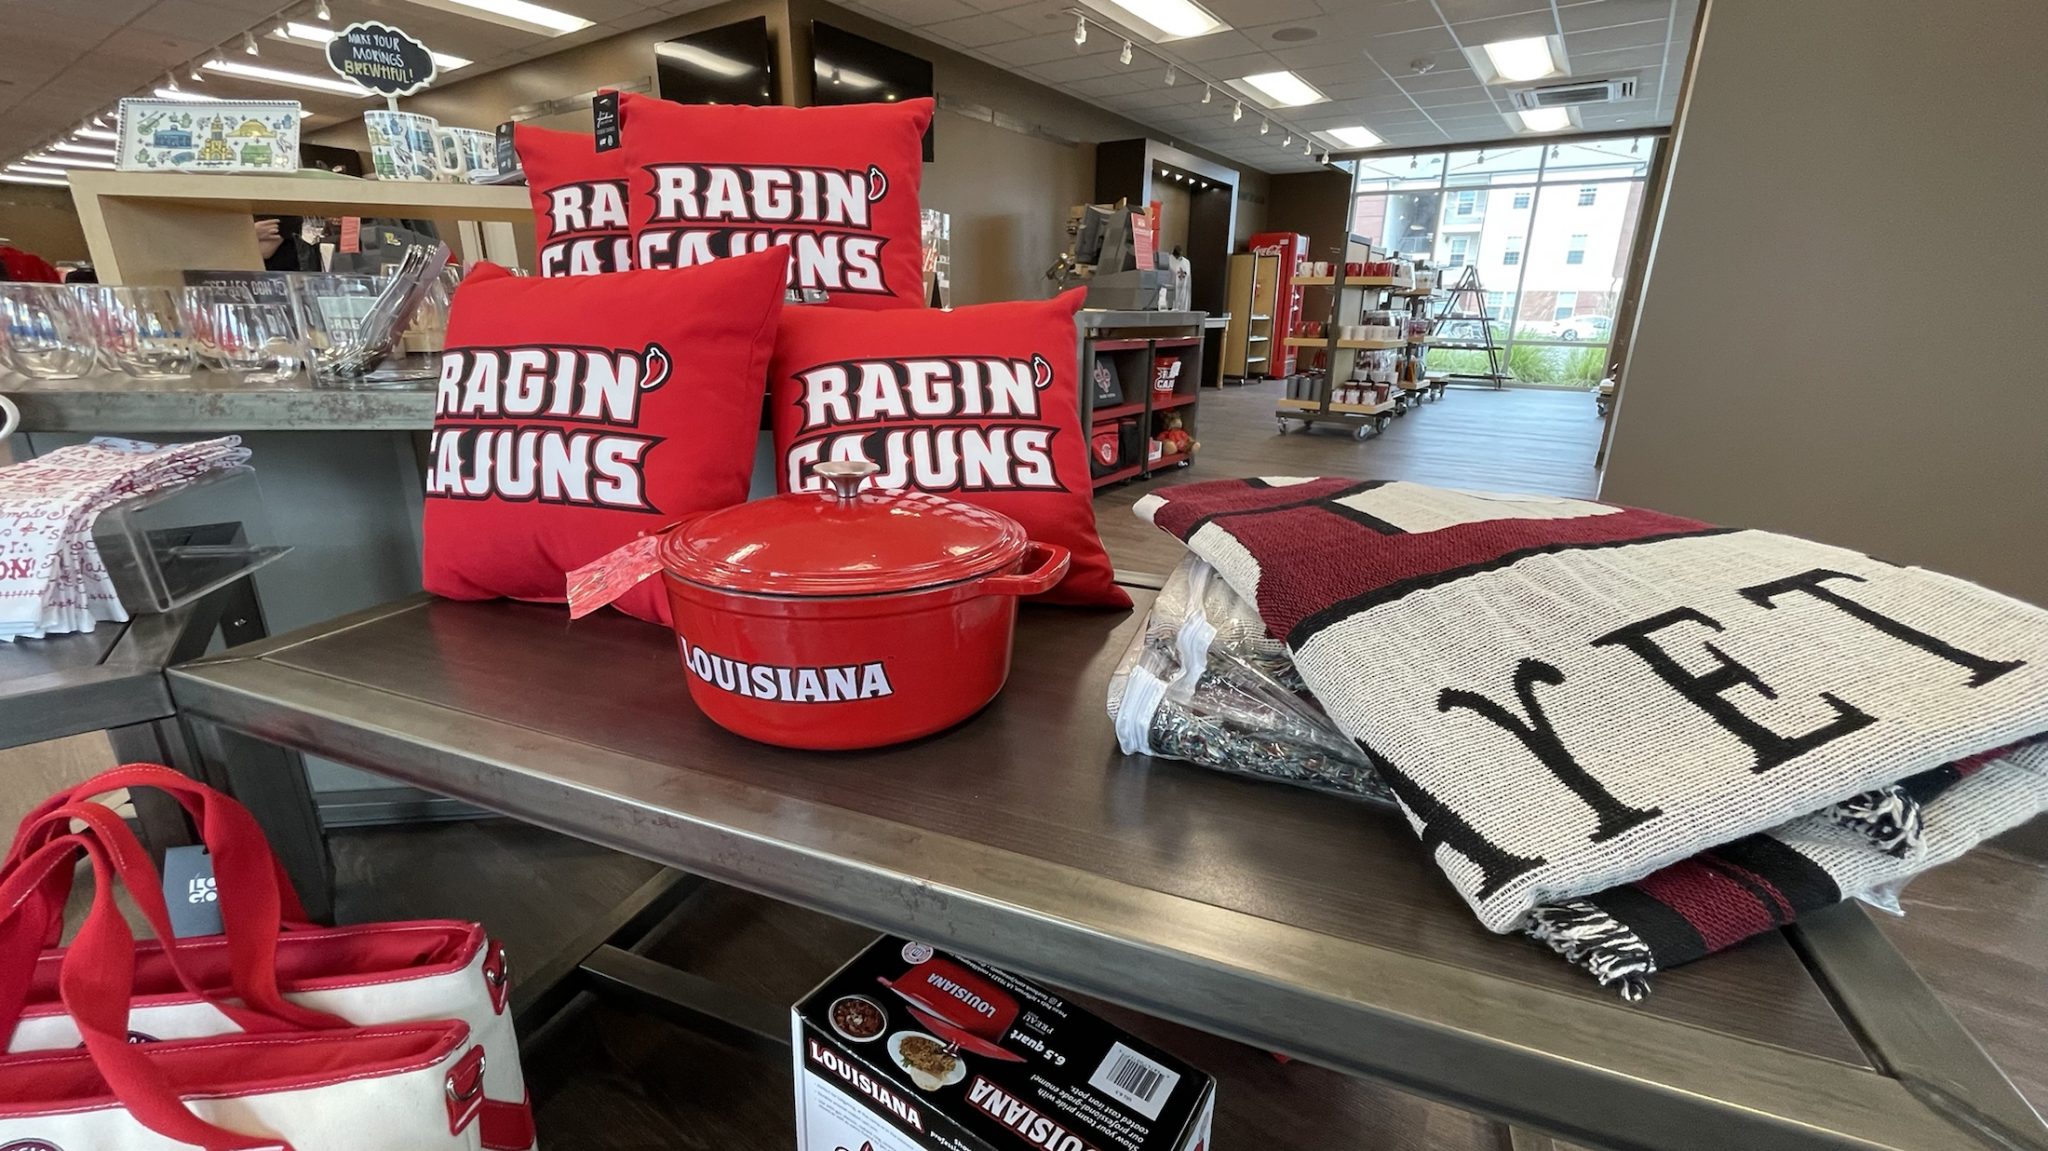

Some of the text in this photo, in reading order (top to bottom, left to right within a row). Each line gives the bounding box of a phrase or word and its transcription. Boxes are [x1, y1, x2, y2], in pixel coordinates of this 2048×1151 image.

[348, 33, 401, 52] MAKE YOUR
[680, 634, 893, 702] LOUISIANA
[927, 972, 997, 1019] LOUISIANA
[1010, 1029, 1065, 1065] 6.5 quart
[809, 1041, 923, 1132] LOUISIANA
[1030, 1074, 1059, 1092] enamel
[1037, 1088, 1055, 1101] with
[968, 1076, 1100, 1151] UISIANA
[1055, 1099, 1077, 1113] pride
[1059, 1090, 1131, 1134] professional-grade
[1071, 1086, 1149, 1134] coated cast iron pots.
[1075, 1111, 1096, 1127] team
[1096, 1124, 1118, 1138] your
[1128, 1132, 1144, 1143] our
